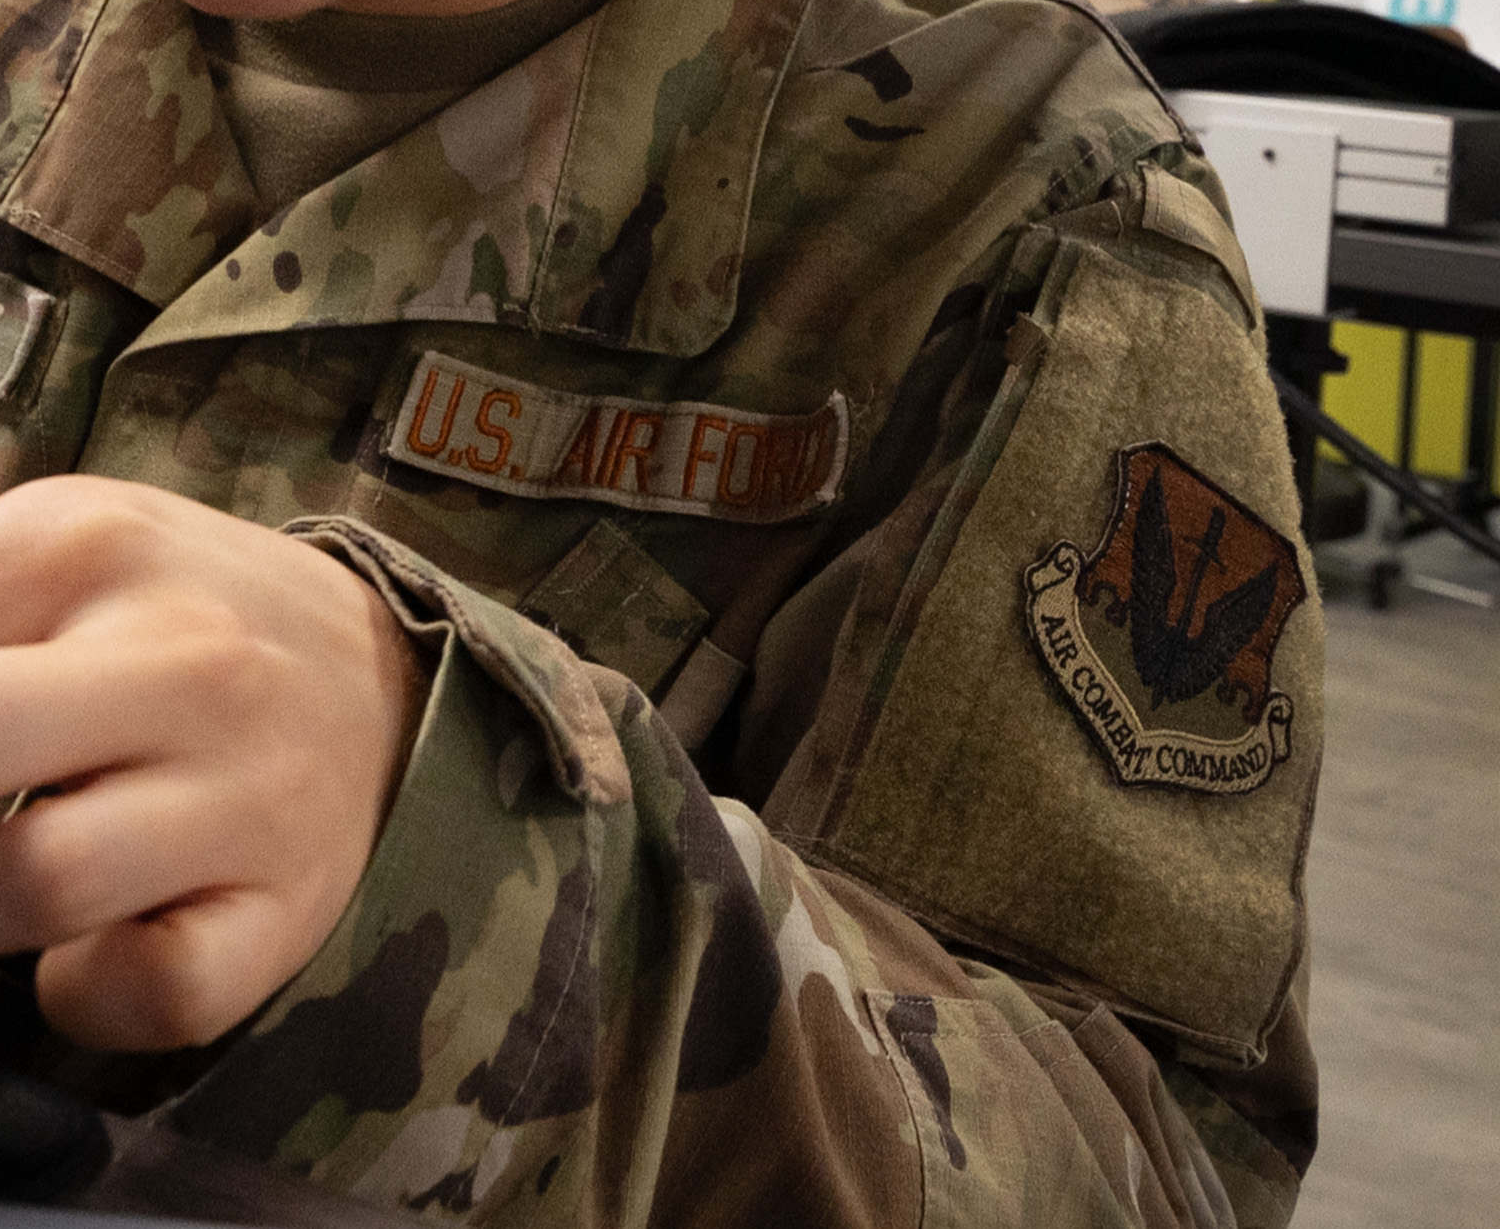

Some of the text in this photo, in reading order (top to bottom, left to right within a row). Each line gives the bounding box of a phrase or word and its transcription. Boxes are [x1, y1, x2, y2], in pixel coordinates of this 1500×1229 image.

[406, 370, 527, 481] U.S.
[556, 406, 665, 495] AIR
[1040, 613, 1268, 783] AIR COMBAT COMMAND
